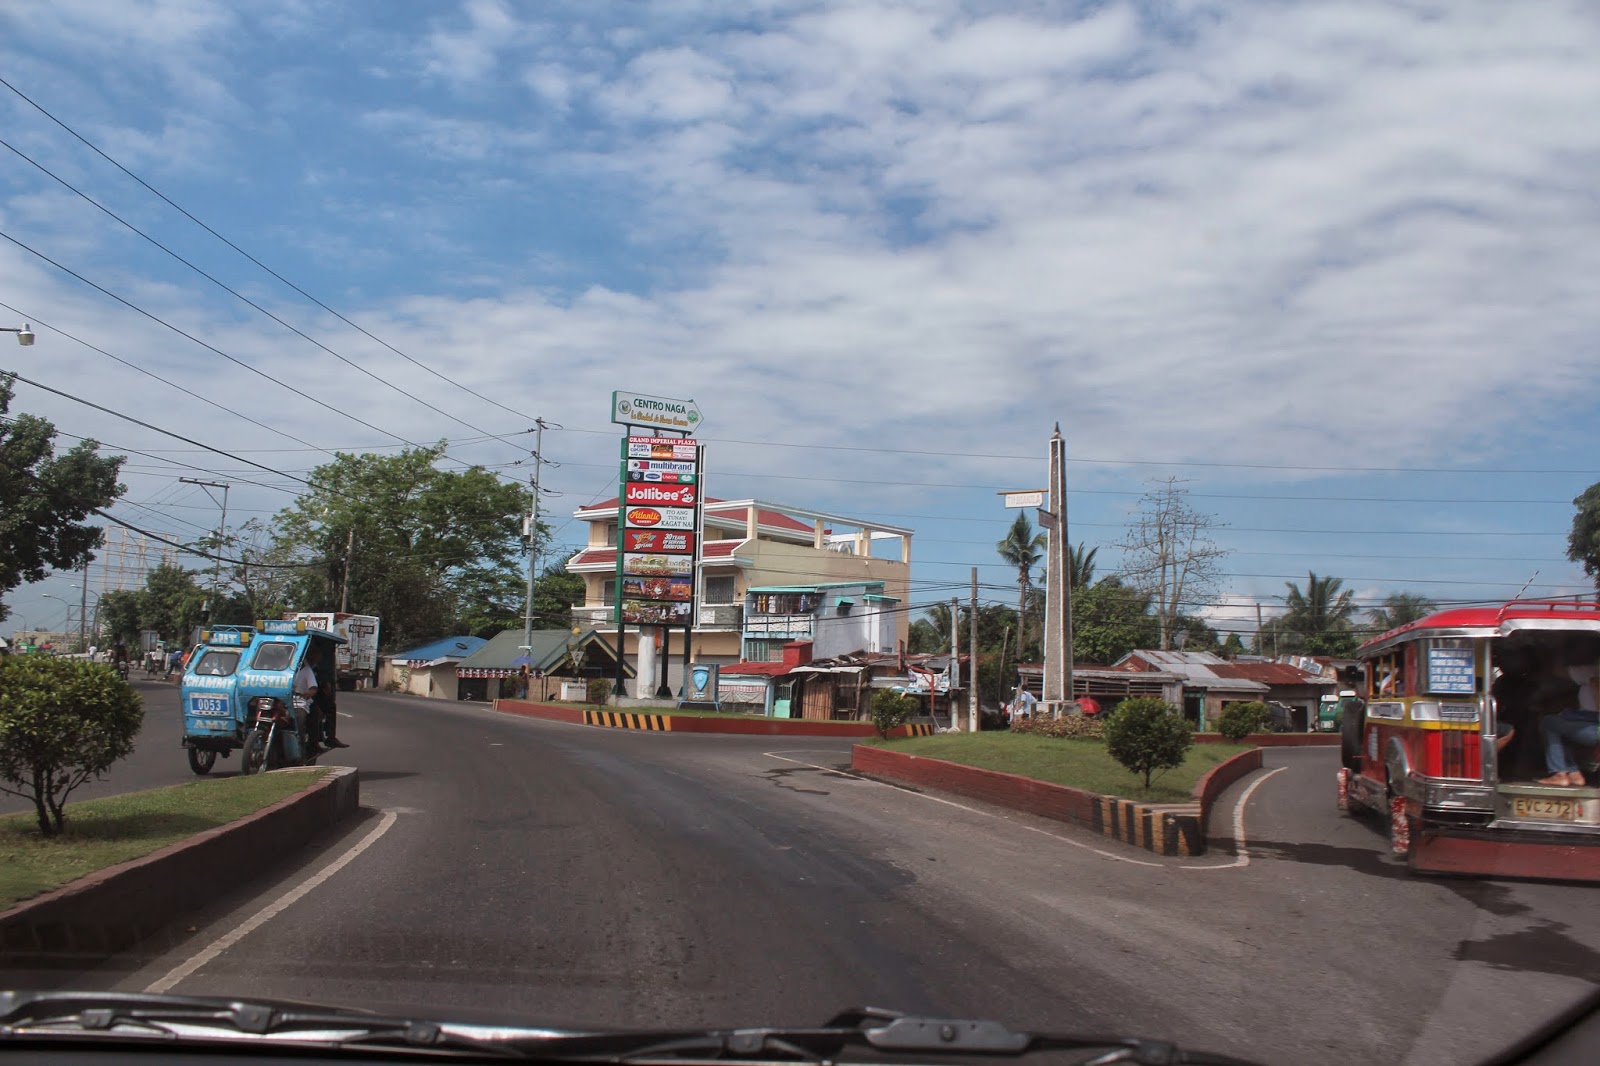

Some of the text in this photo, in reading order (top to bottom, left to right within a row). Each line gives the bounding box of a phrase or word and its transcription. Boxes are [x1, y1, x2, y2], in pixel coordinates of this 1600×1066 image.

[633, 399, 686, 414] CENTRO NAGA
[650, 461, 692, 471] multibrand
[627, 487, 679, 500] Jollibee
[629, 510, 660, 520] Atlantic
[240, 673, 294, 688] JUSTIN
[197, 699, 222, 711] 0053
[194, 720, 229, 730] AMY
[1516, 799, 1570, 814] EVC 272
